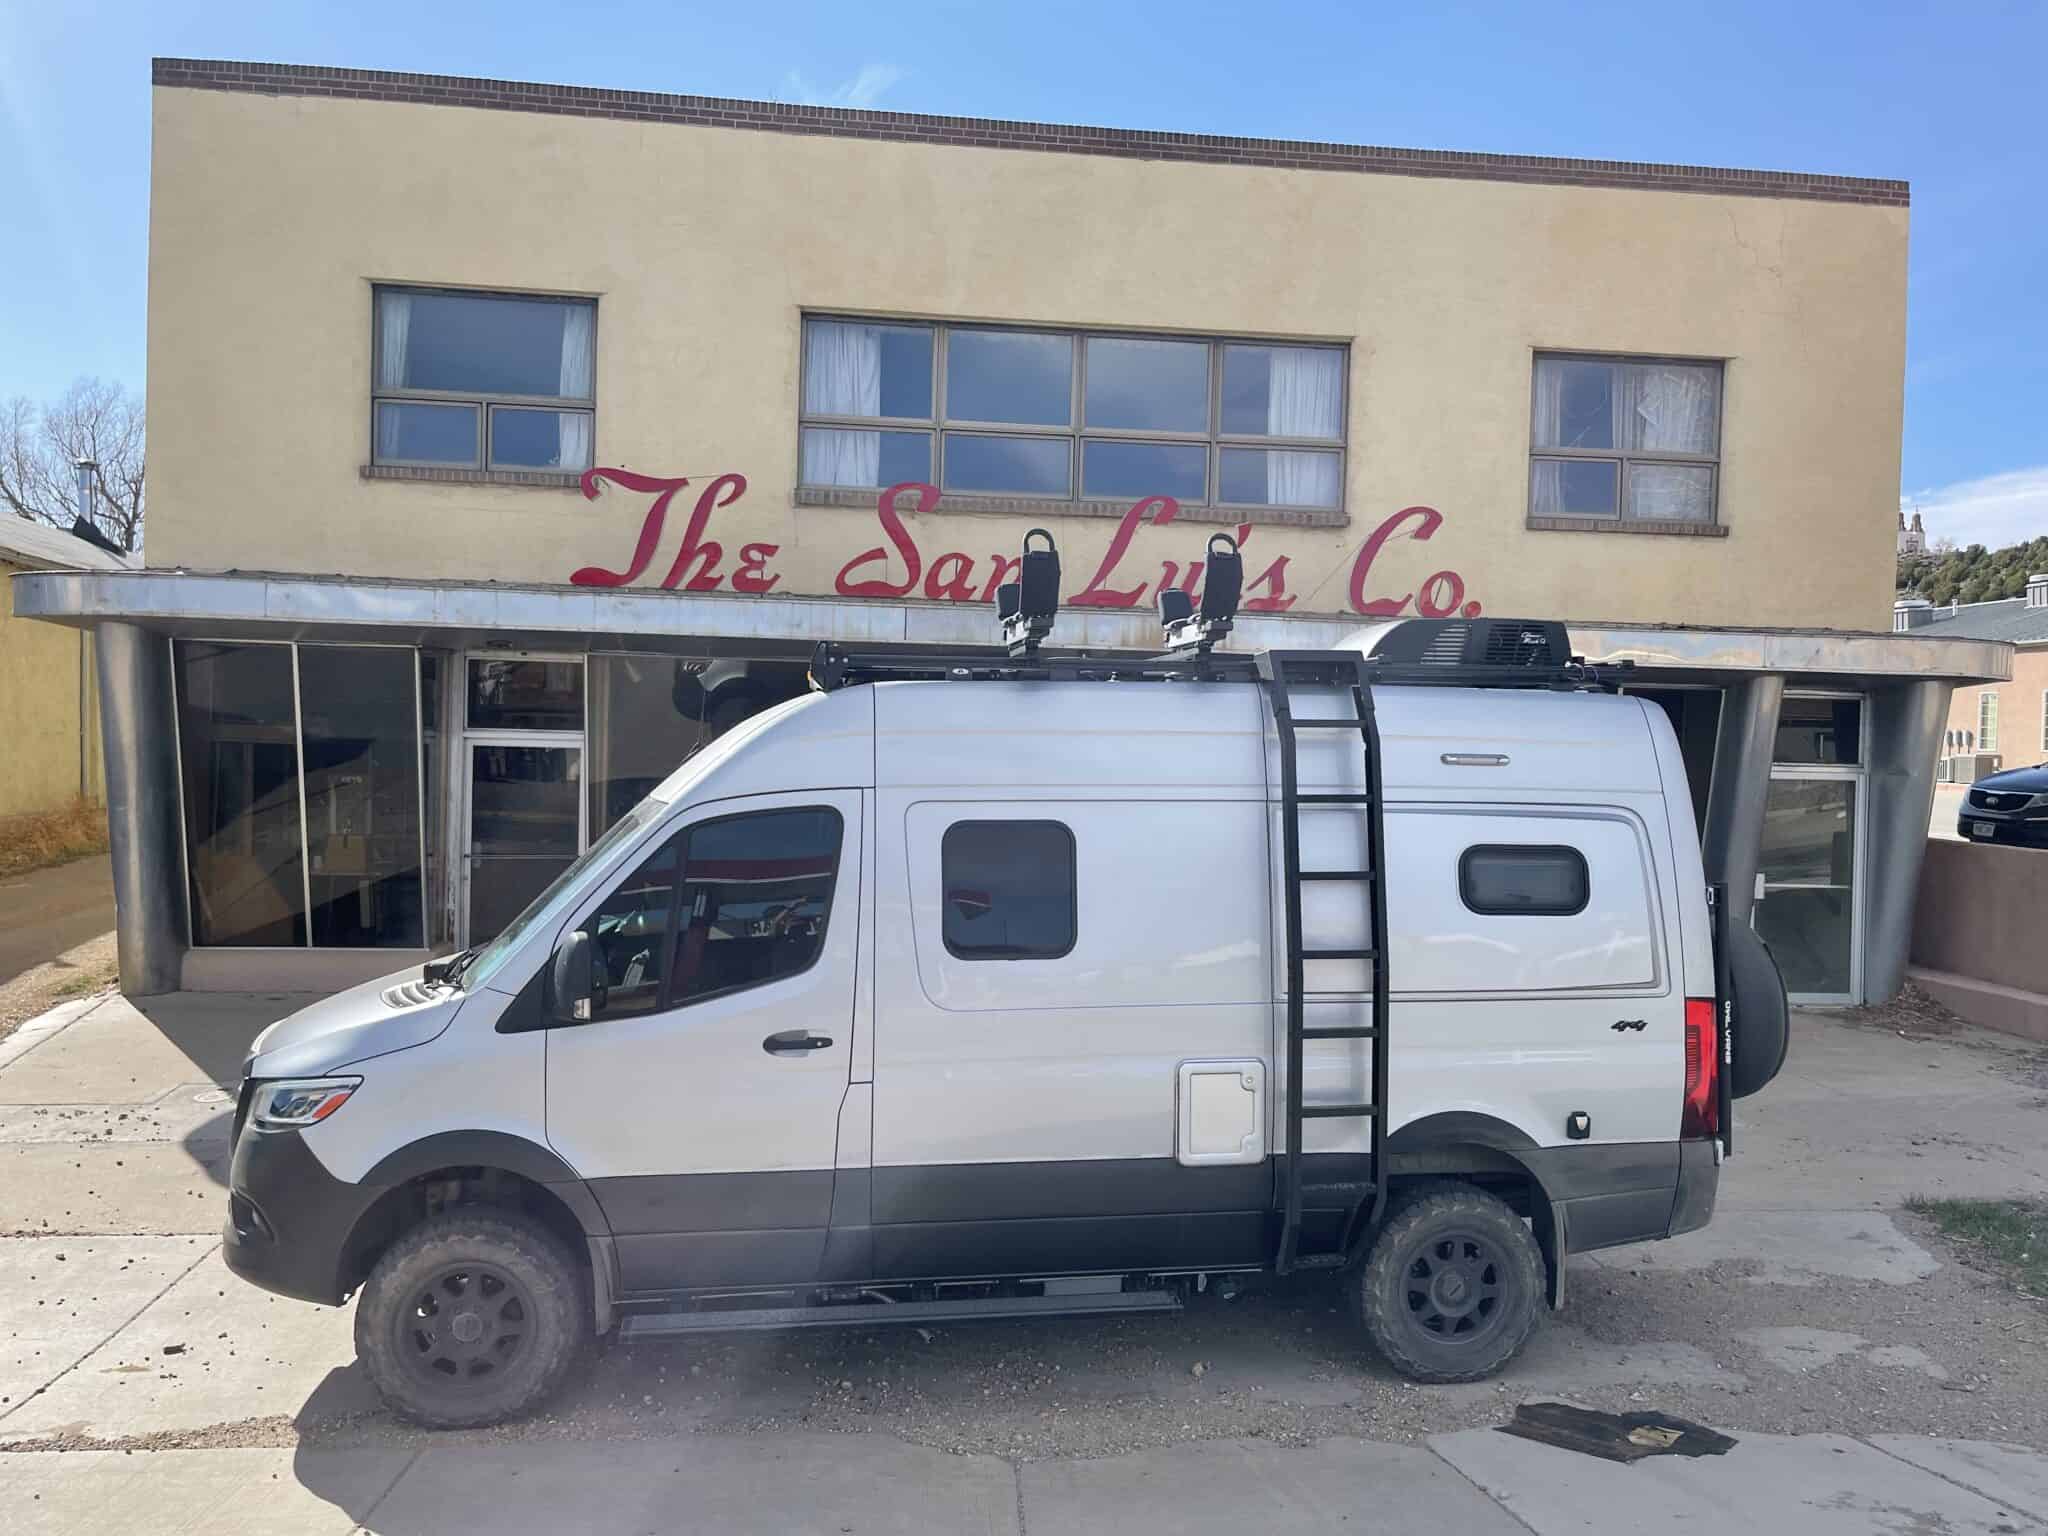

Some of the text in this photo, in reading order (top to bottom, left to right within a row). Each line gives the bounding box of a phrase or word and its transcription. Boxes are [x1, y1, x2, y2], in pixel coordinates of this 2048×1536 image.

[570, 467, 1482, 618] The San Lus Co.
